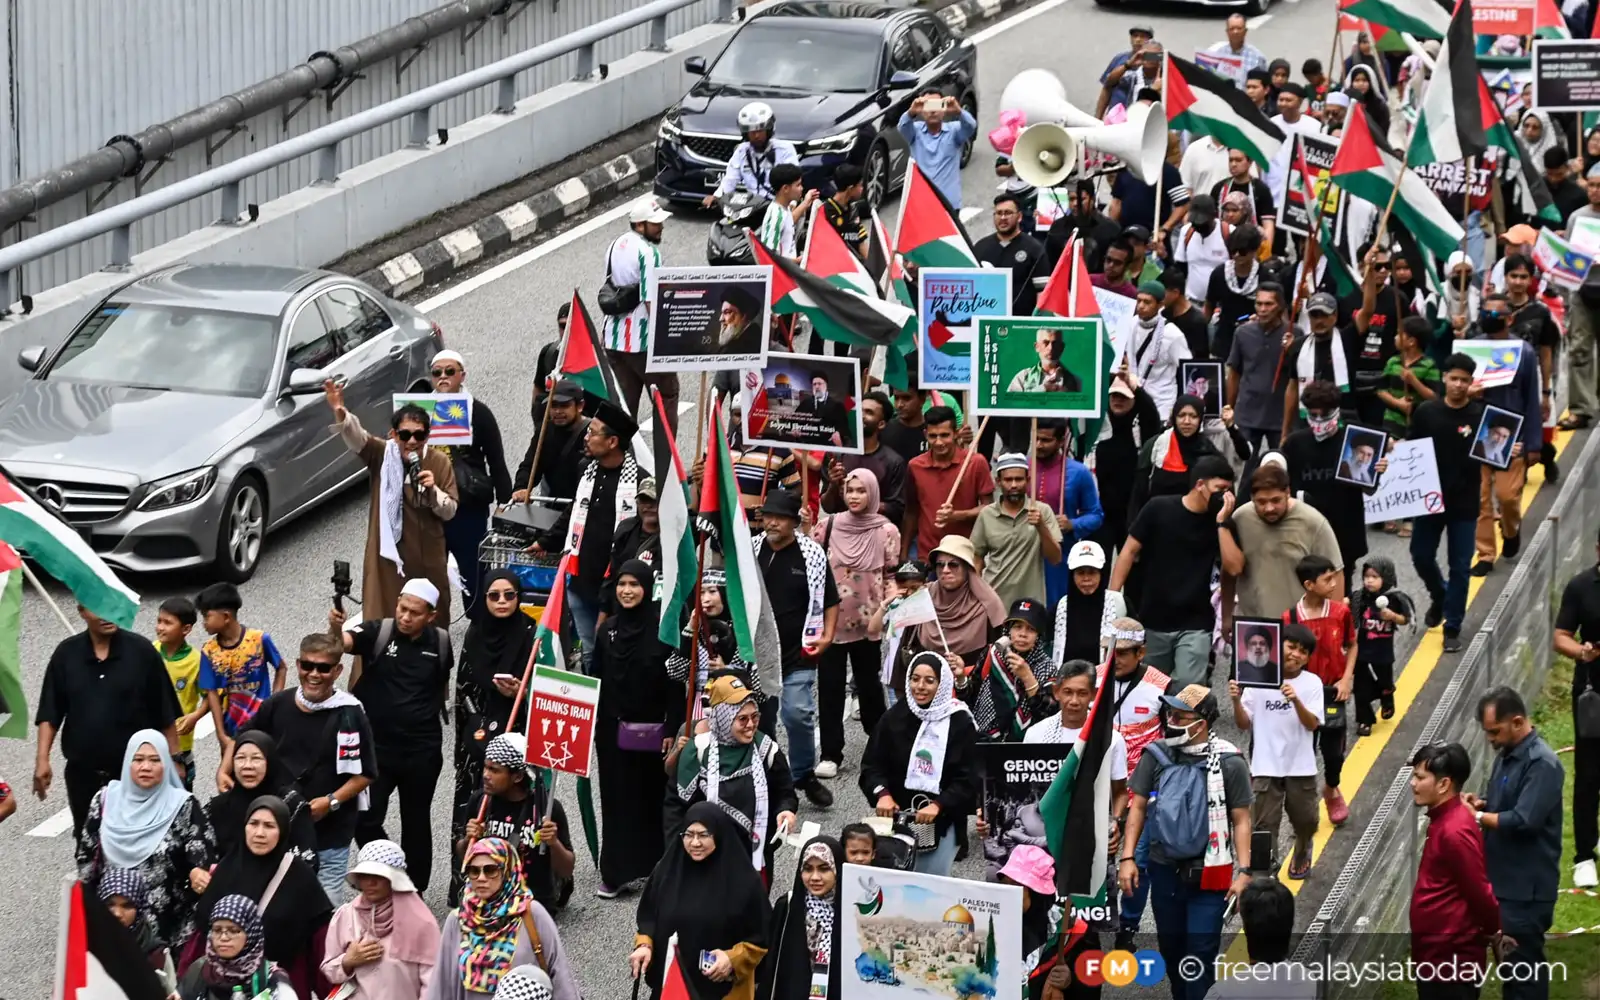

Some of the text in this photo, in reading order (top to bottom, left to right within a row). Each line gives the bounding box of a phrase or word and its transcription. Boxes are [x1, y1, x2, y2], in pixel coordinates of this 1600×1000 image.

[1413, 162, 1491, 185] ARREST
[930, 284, 969, 294] FREE
[930, 292, 998, 314] Palestine
[991, 343, 1000, 405] SINWAR
[1385, 489, 1427, 509] ISRAEL
[535, 697, 591, 720] THANKS IRAN
[1003, 759, 1067, 772] GENOCI
[1006, 773, 1019, 783] IN
[962, 897, 1001, 910] PALESTINE
